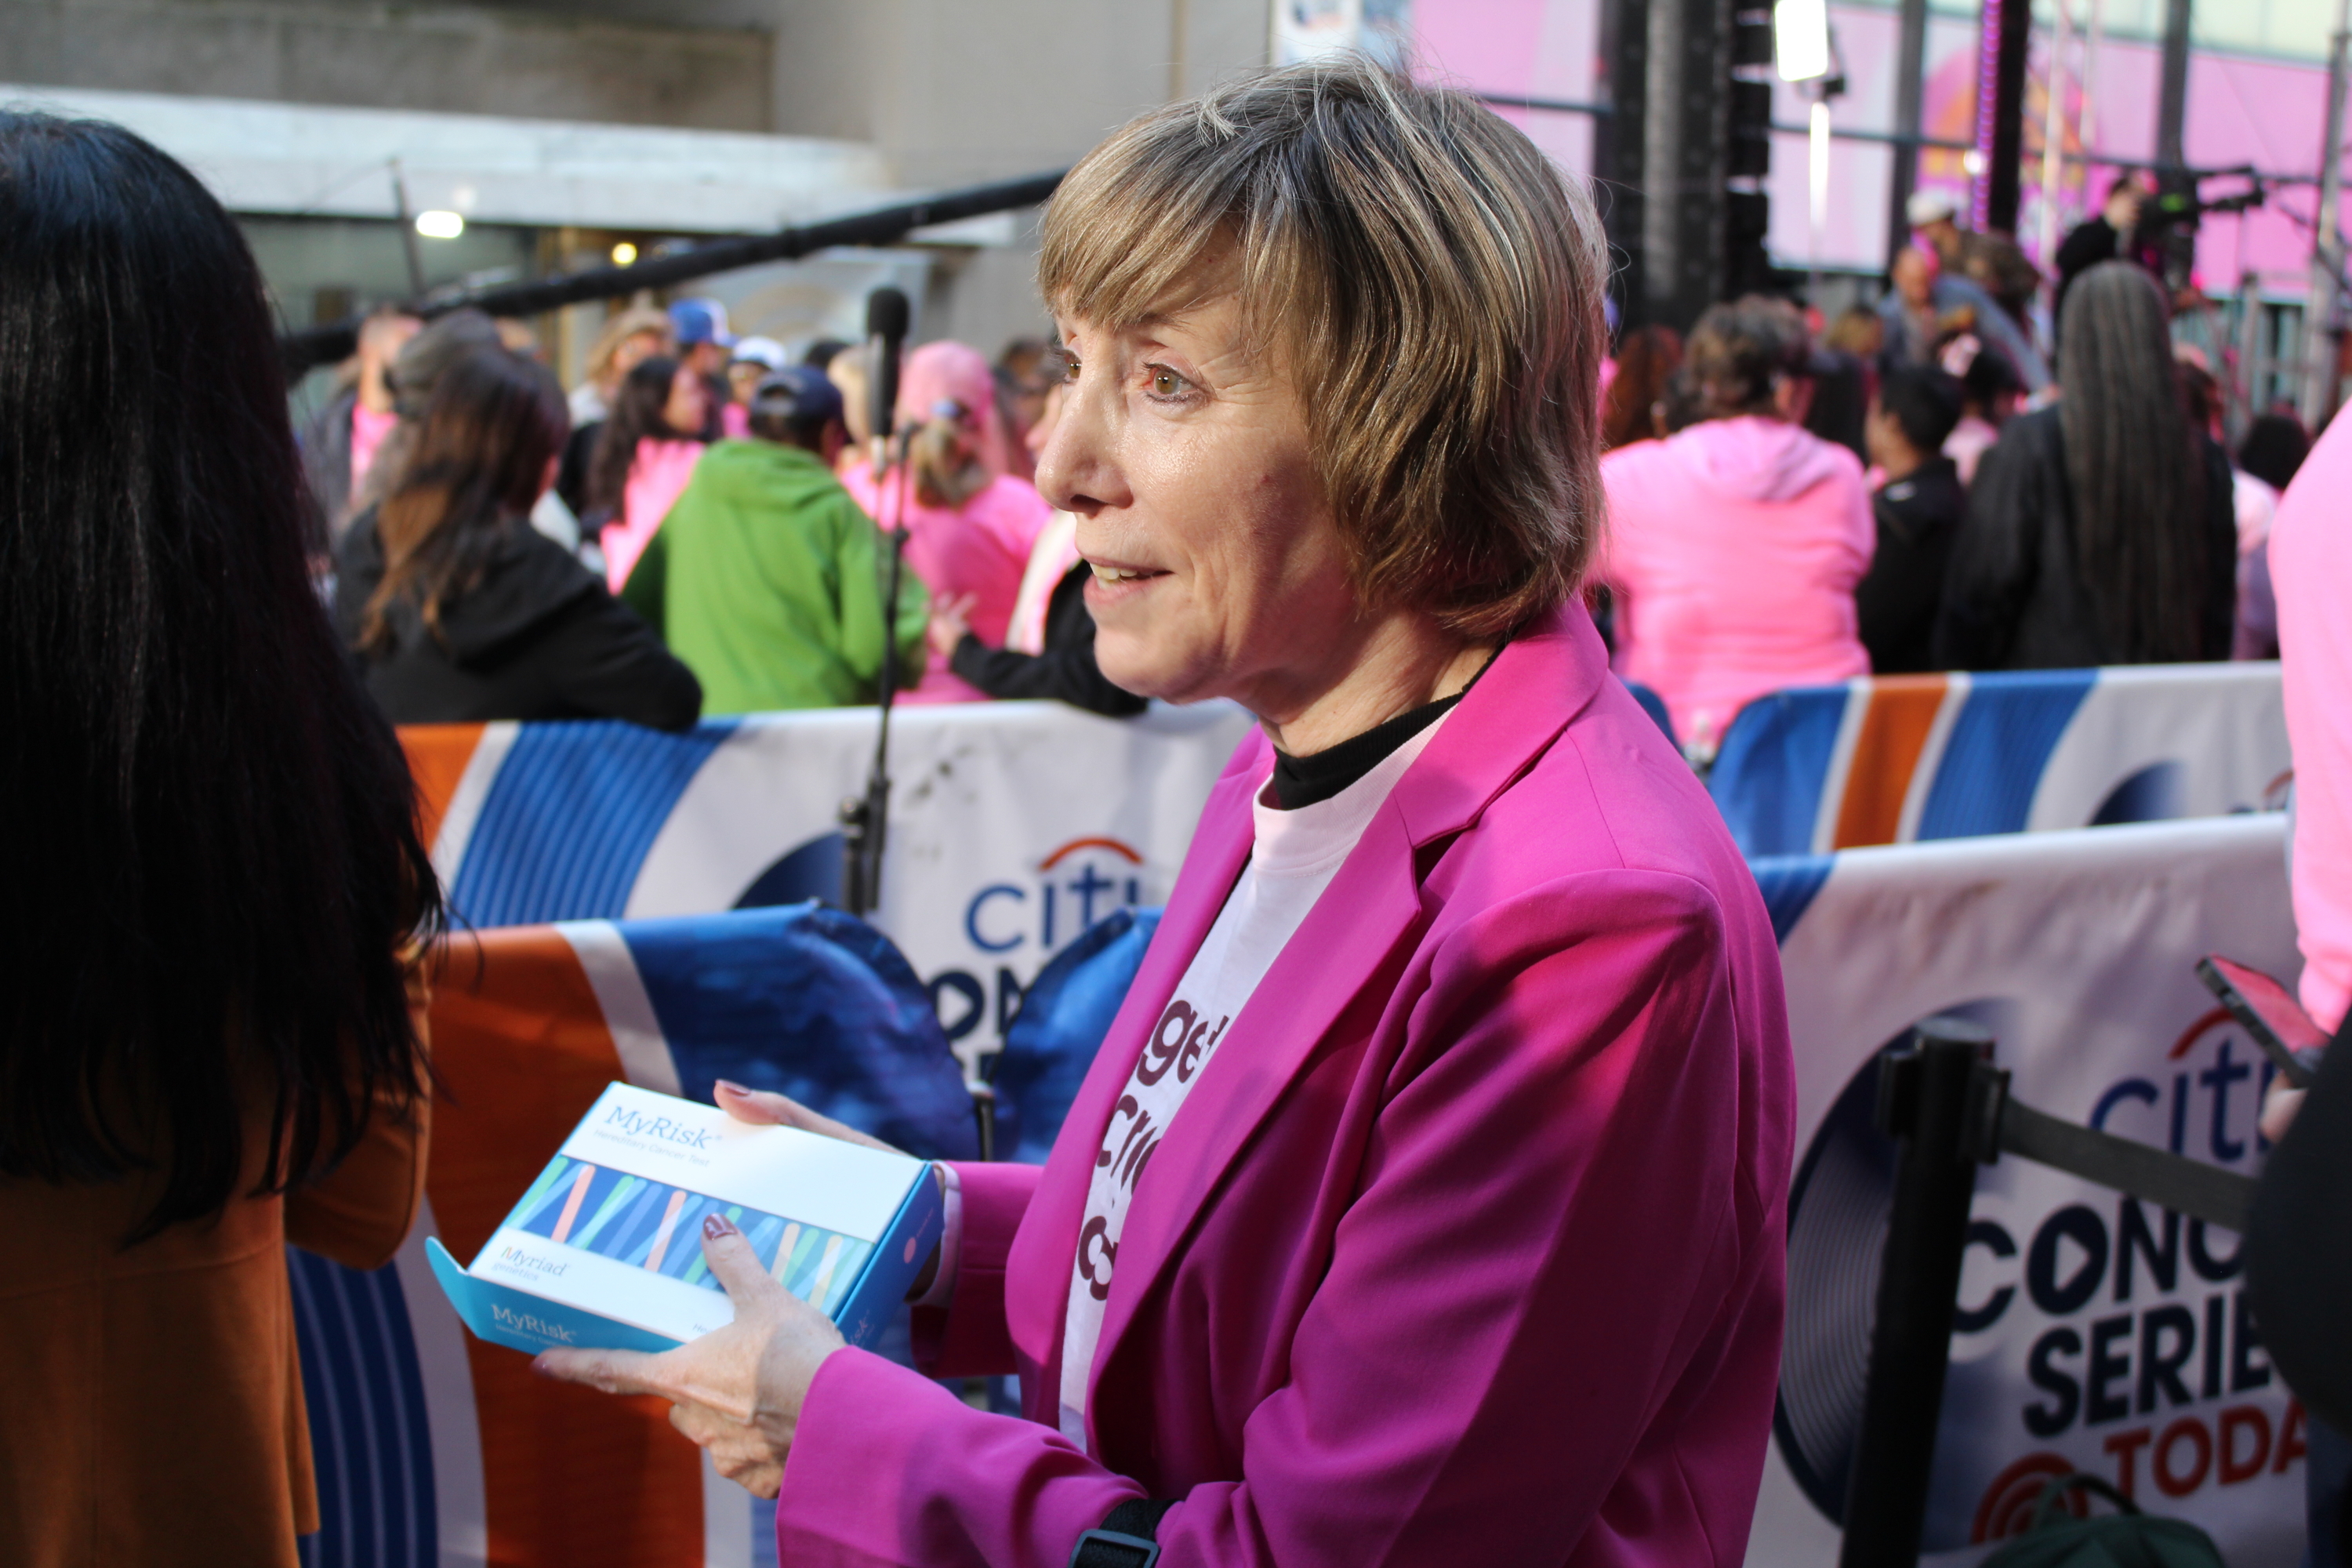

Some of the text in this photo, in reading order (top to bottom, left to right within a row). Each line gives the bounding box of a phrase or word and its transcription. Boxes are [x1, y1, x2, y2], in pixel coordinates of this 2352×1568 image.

[593, 1129, 710, 1167] Hereditary Cancer Test
[492, 1261, 539, 1281] genetics
[2021, 1290, 2270, 1437] SERIE
[2104, 1400, 2307, 1498] TODA
